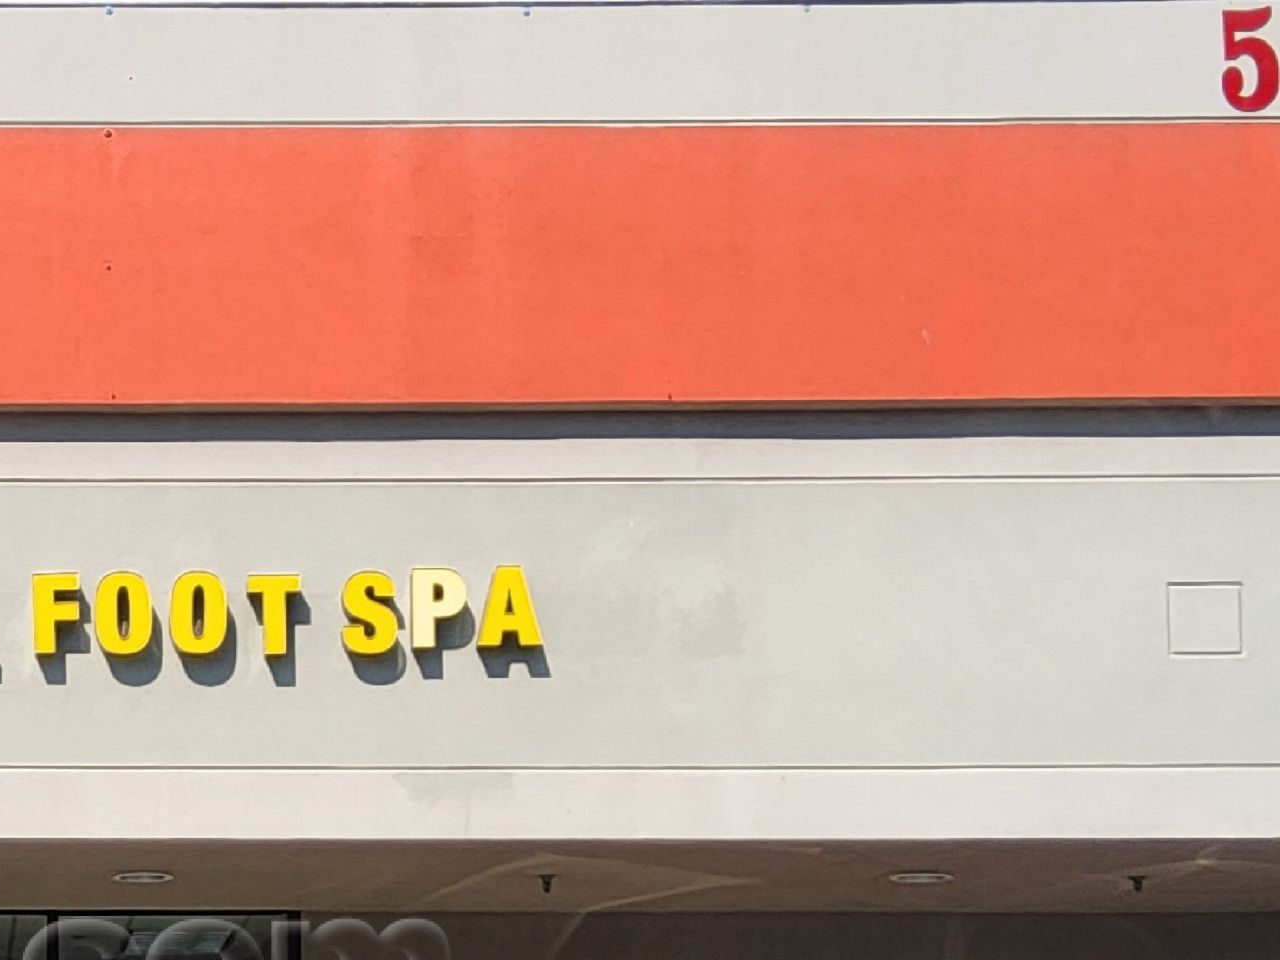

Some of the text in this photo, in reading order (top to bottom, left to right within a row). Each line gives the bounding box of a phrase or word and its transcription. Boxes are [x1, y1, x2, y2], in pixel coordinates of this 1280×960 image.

[1222, 5, 1279, 112] 5
[32, 570, 301, 658] FOOT
[341, 564, 543, 655] SPA
